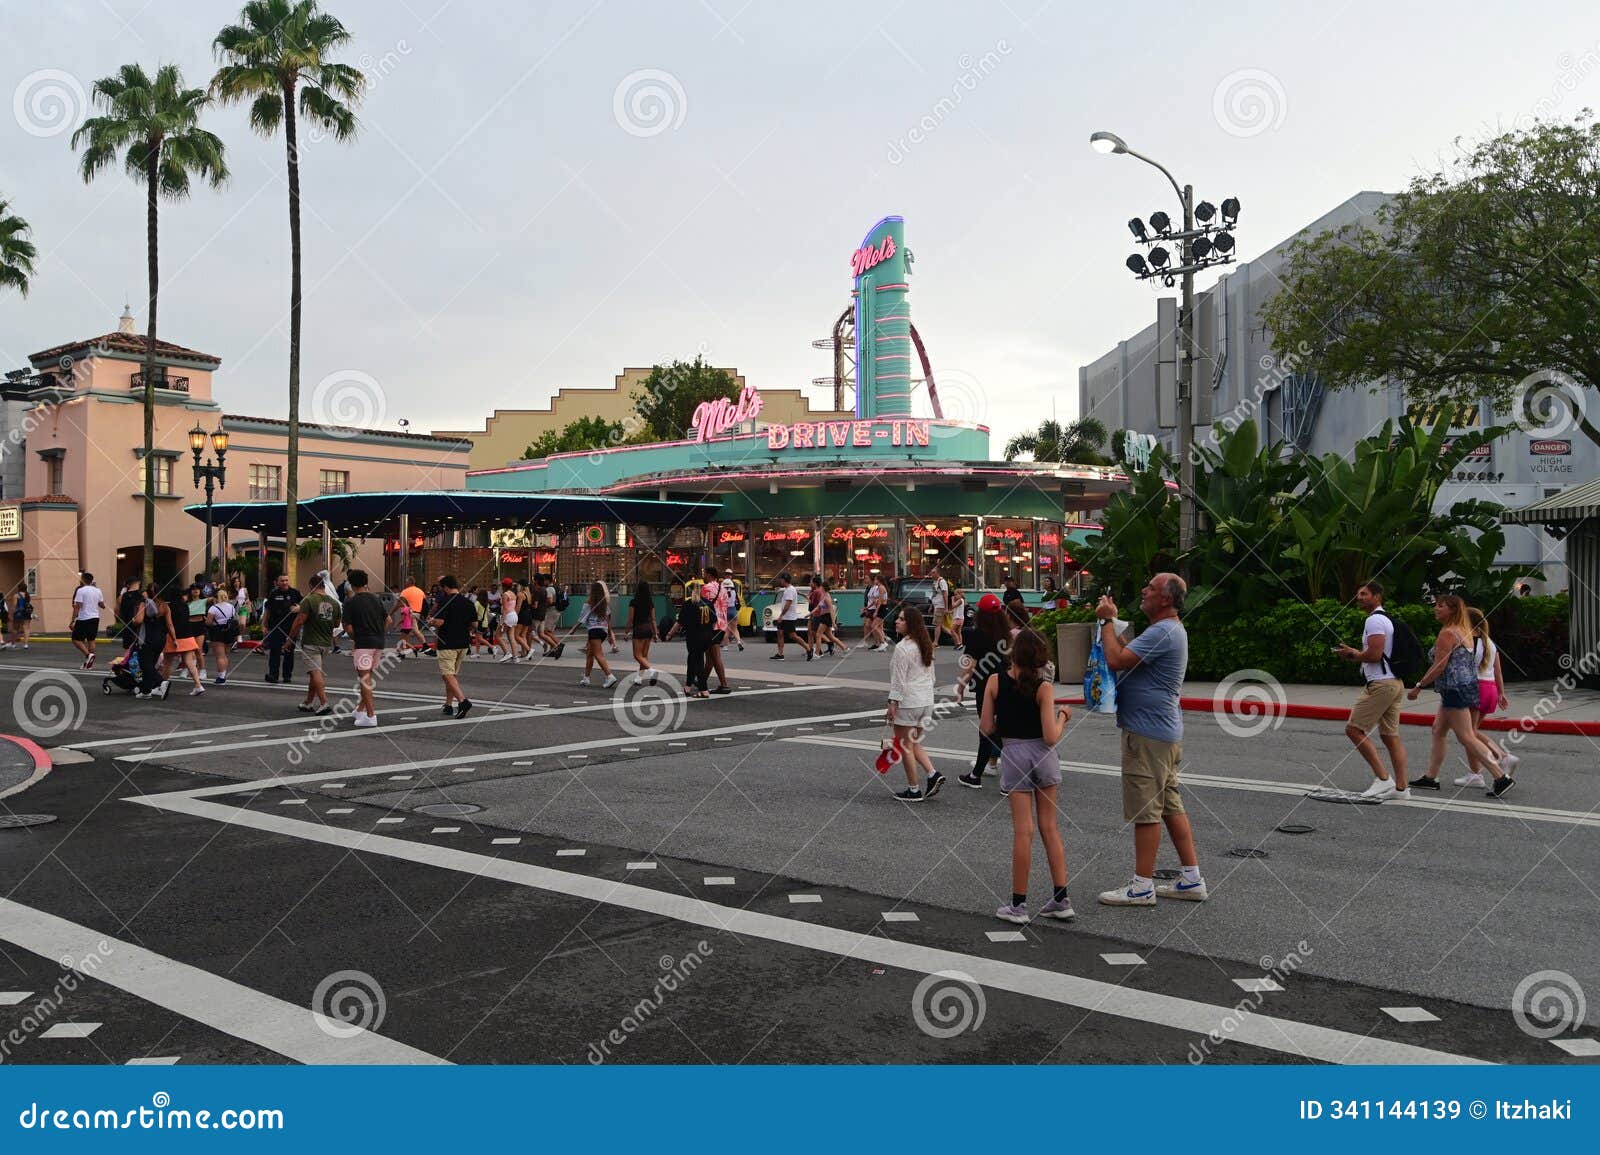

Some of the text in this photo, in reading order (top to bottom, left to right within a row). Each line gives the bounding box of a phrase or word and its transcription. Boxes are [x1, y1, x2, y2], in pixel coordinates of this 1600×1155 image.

[850, 235, 896, 279] Mel's
[692, 386, 764, 443] Mel's
[767, 420, 929, 450] DRIVE-IN
[1540, 457, 1563, 465] HIGH
[1530, 465, 1573, 473] VOLTAGE
[720, 531, 744, 543] Shakes
[831, 527, 855, 542] Soft
[985, 526, 1023, 540] Onion Rings
[501, 553, 523, 563] Fries
